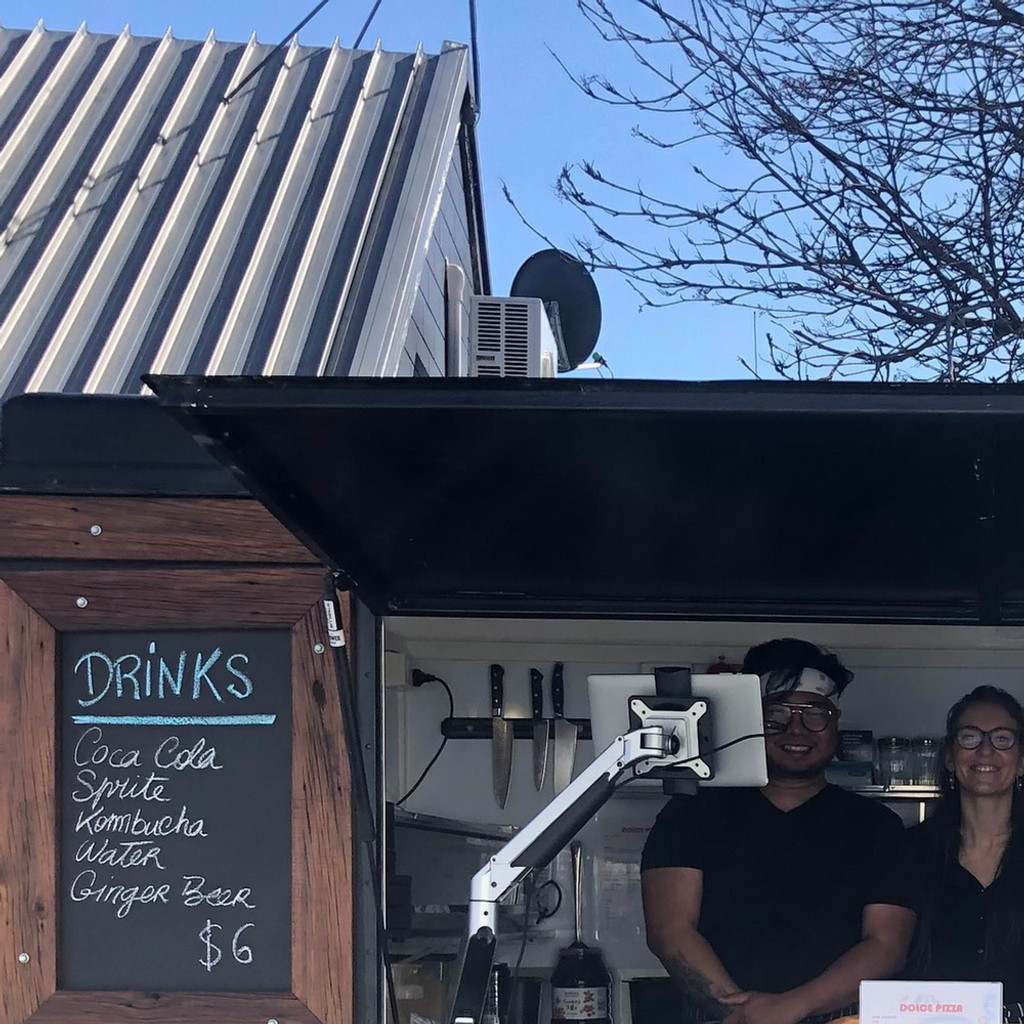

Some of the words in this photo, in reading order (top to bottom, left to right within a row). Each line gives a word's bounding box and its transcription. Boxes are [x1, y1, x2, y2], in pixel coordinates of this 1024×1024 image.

[73, 726, 143, 771] Coca
[153, 735, 224, 771] Cola
[71, 769, 172, 809] Sprite
[75, 805, 209, 837] Kombucha
[899, 1003, 933, 1013] DOLCE
[935, 1003, 963, 1013] PIZZA
